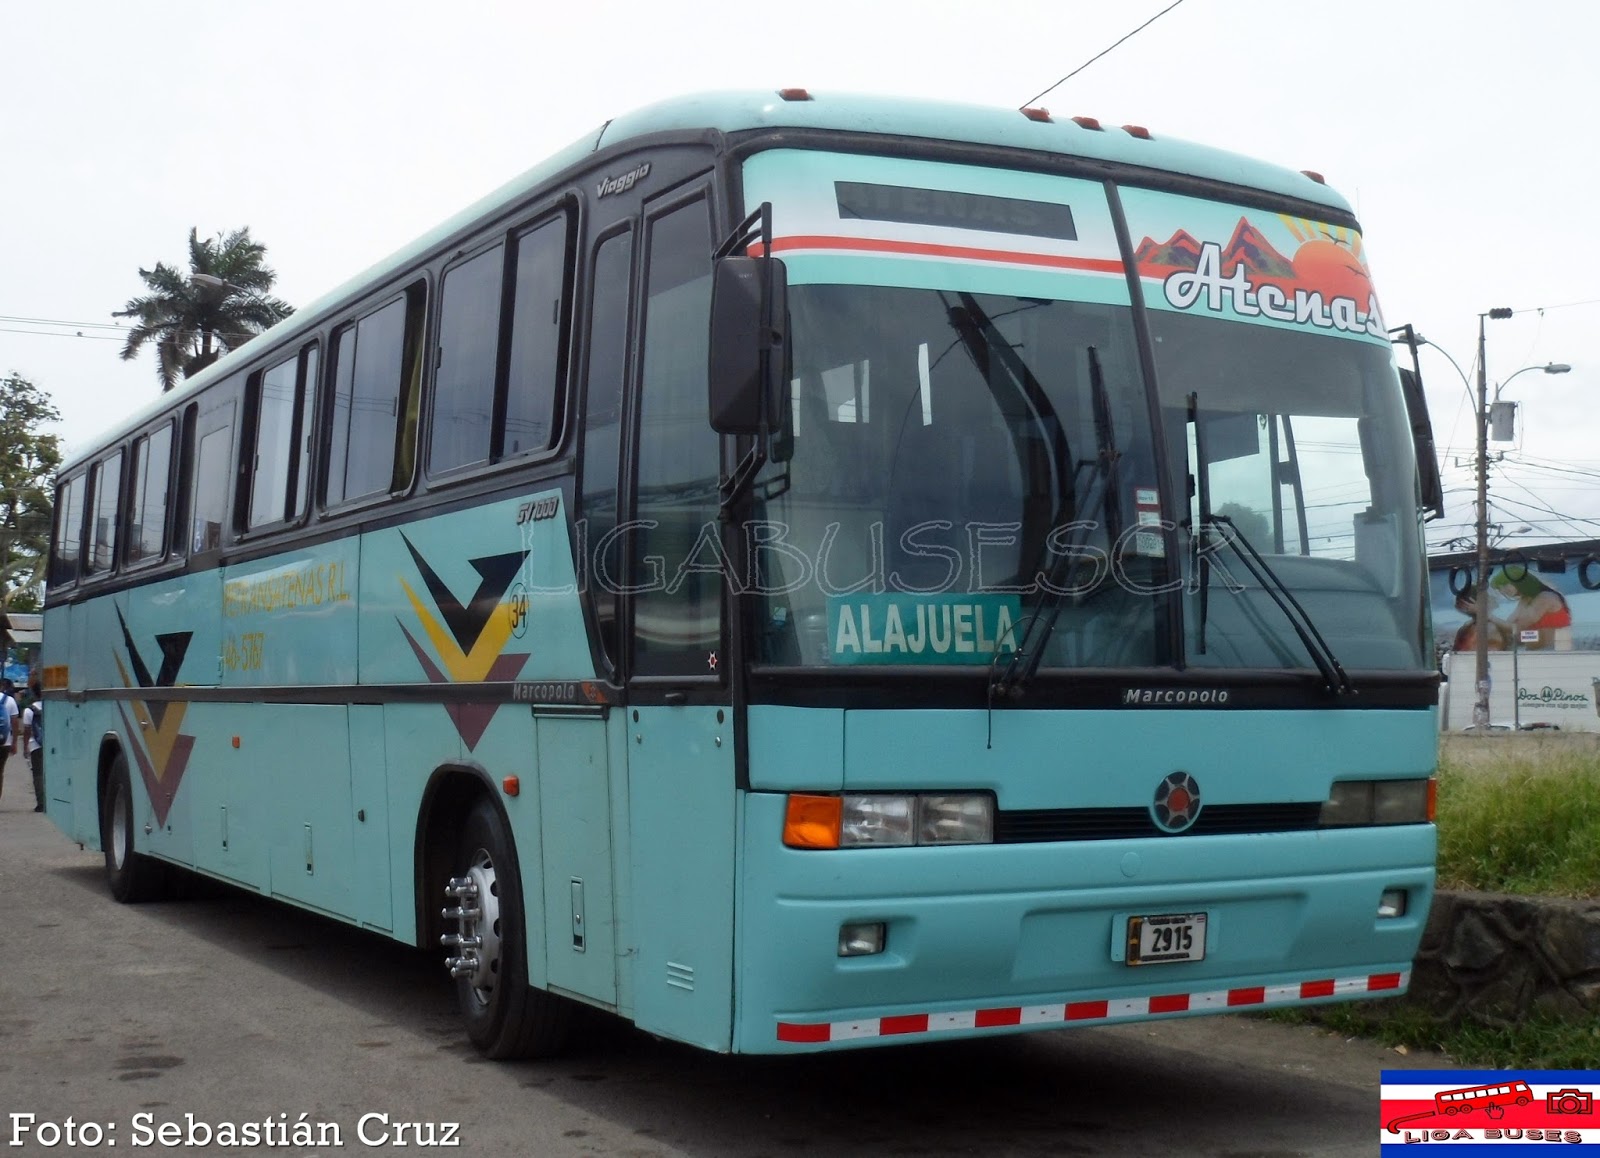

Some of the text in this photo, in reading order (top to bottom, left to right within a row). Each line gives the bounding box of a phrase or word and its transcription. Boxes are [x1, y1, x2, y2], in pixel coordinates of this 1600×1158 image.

[596, 163, 650, 199] Viaggio
[1163, 241, 1390, 342] Atenas
[511, 594, 527, 629] 34
[835, 604, 1017, 653] ALAJUELA
[513, 682, 575, 701] Marcopolo
[1123, 688, 1229, 704] Marcopolo
[1518, 687, 1588, 701] Dos Pinos
[1152, 925, 1192, 953] 2915
